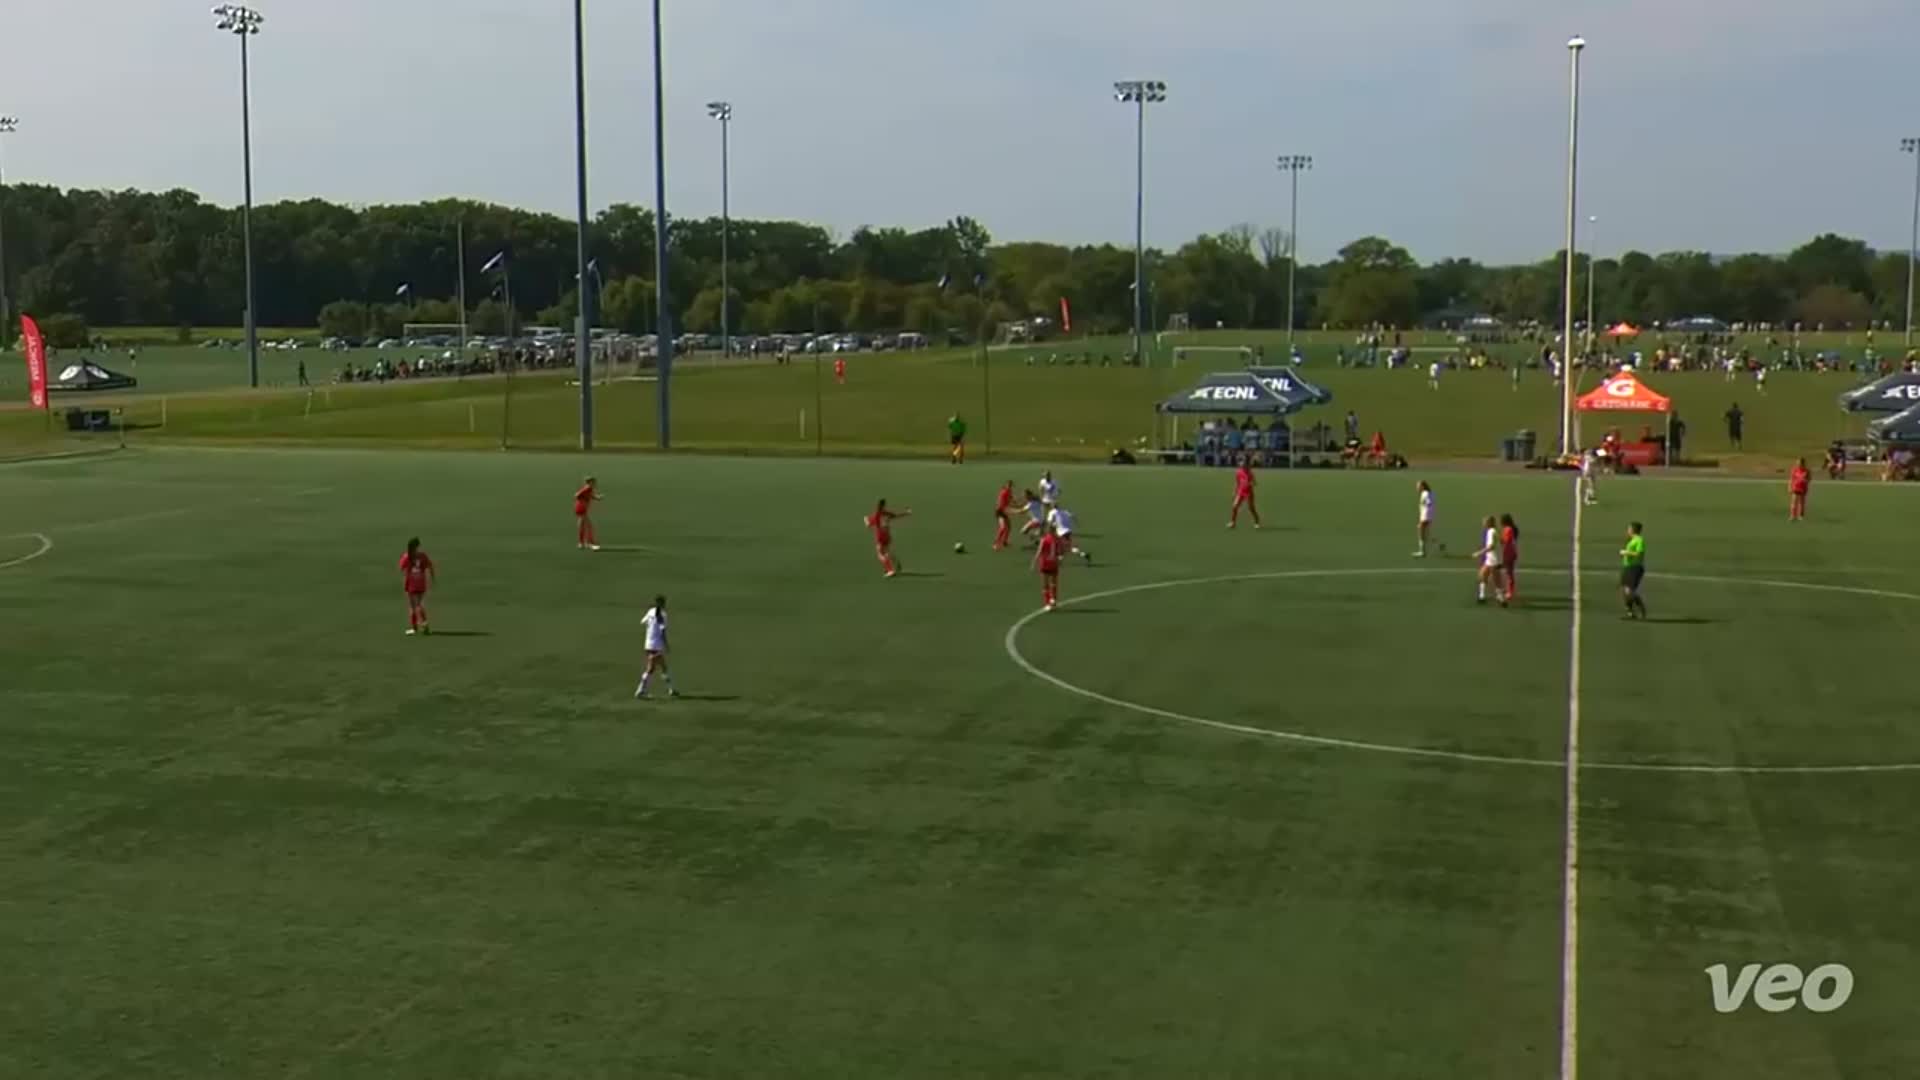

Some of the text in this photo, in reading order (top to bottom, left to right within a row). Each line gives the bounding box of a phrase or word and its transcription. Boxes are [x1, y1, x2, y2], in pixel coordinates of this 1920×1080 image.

[1212, 386, 1259, 400] ECNL
[1607, 379, 1635, 397] G
[1906, 384, 1920, 399] E
